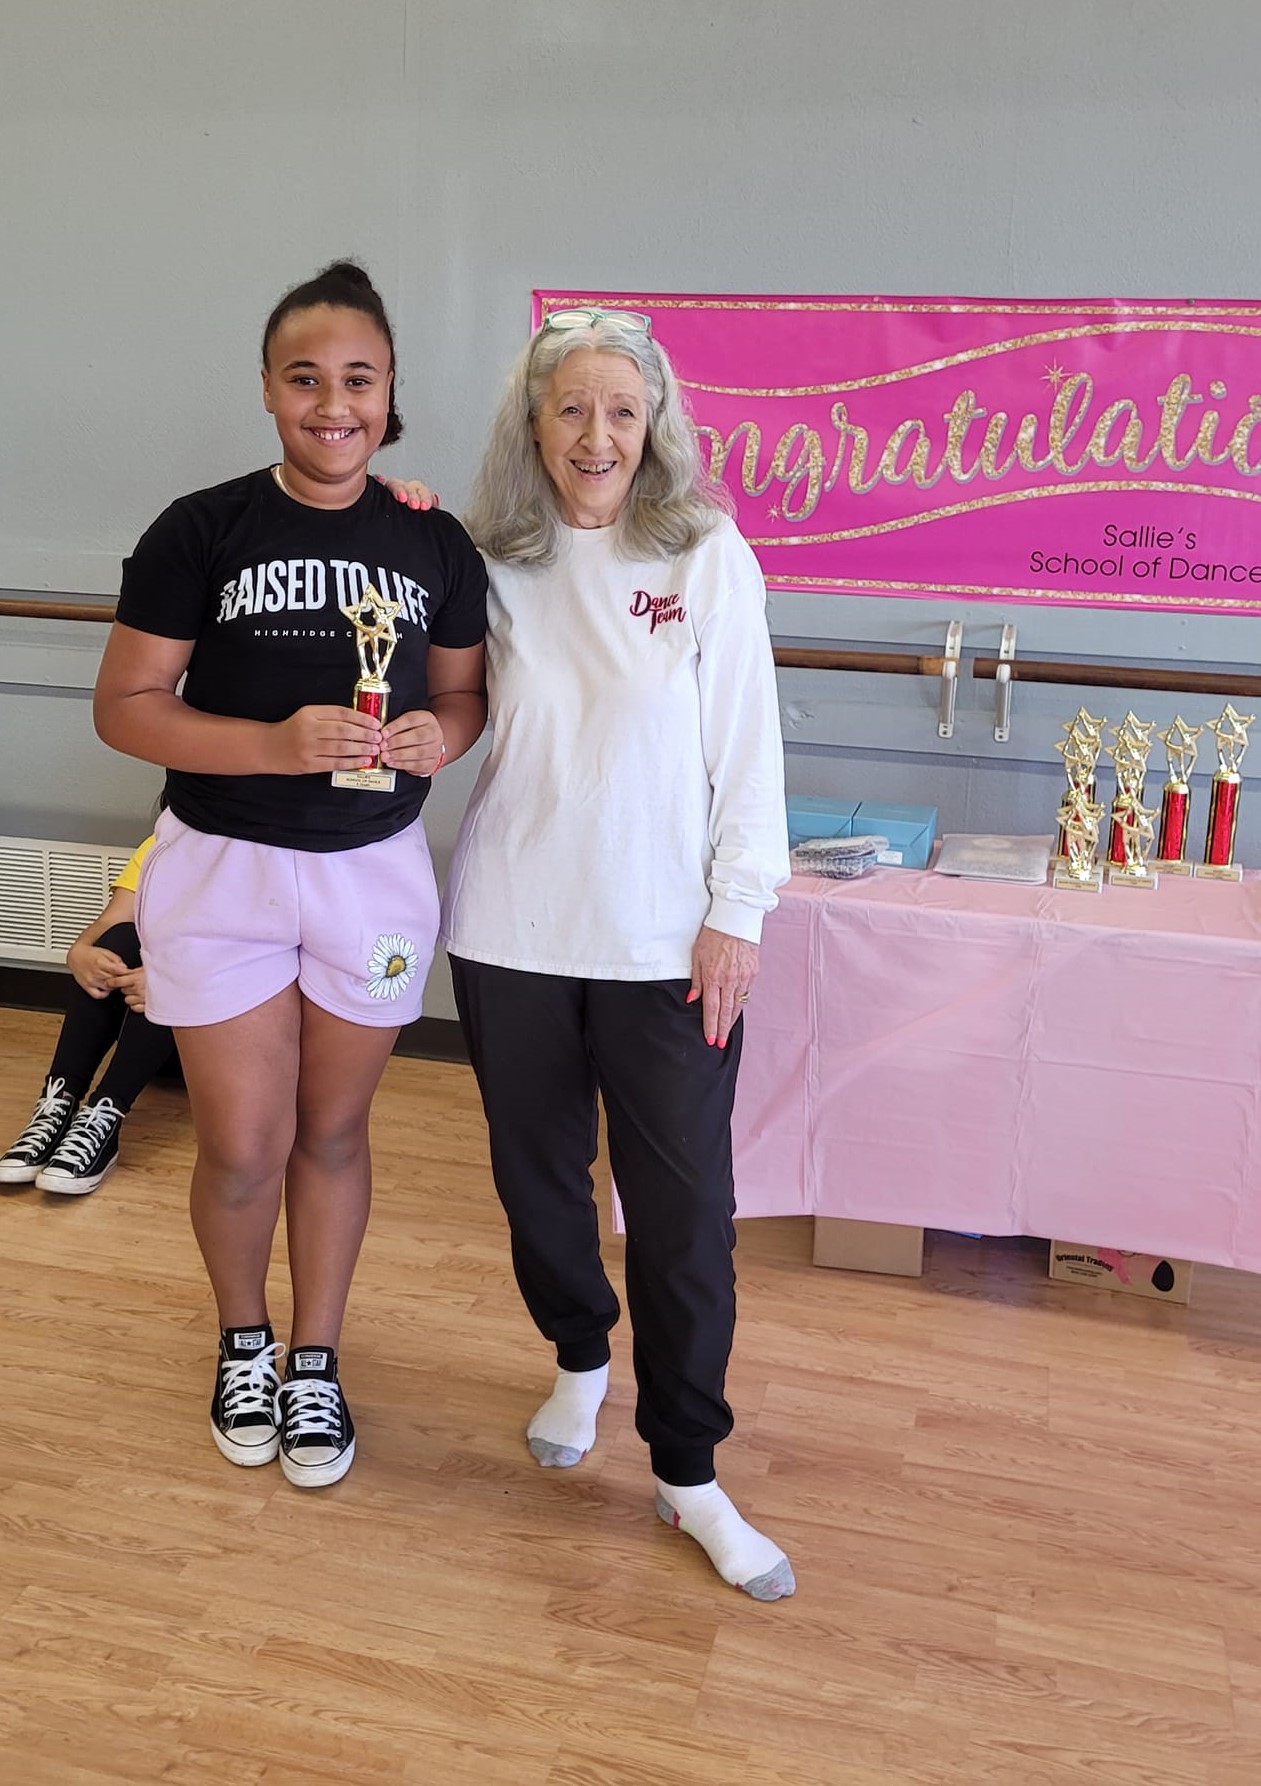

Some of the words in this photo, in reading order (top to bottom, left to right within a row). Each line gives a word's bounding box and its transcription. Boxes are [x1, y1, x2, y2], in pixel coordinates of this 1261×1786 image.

[1103, 524, 1197, 550] Sallie's
[1029, 551, 1124, 577] School
[1132, 556, 1162, 578] of
[1169, 557, 1261, 583] Dance
[329, 559, 373, 613] TO
[629, 590, 680, 617] Dance
[254, 629, 336, 638] HIGHRIDGE
[647, 606, 687, 635] Team
